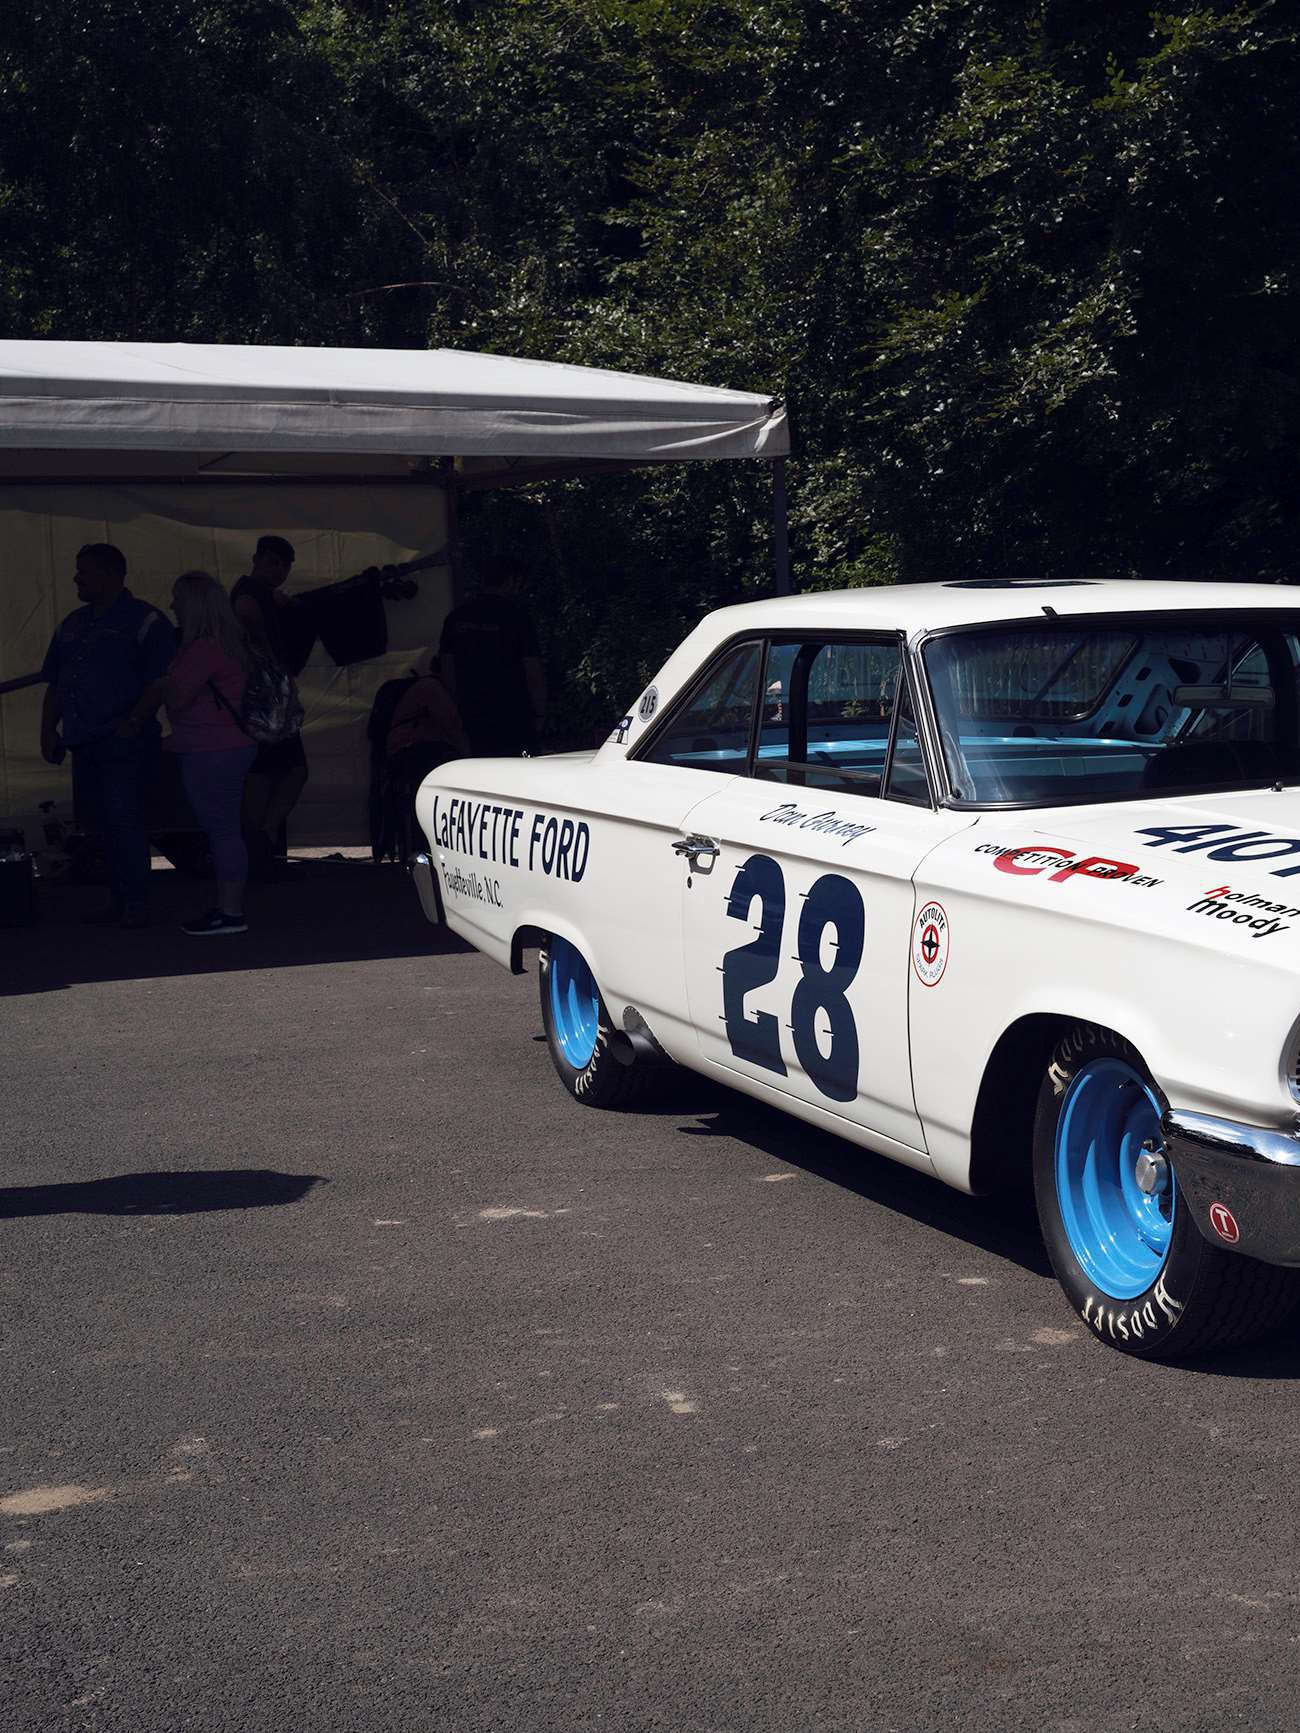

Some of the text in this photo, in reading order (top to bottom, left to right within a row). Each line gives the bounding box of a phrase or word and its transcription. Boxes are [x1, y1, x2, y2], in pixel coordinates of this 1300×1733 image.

[433, 795, 590, 883] LaFAYETTE FORD
[974, 844, 1165, 888] COMPETITION PROVEN
[919, 907, 946, 933] AUTOLITE
[1185, 898, 1291, 939] moody
[718, 853, 866, 1103] 28
